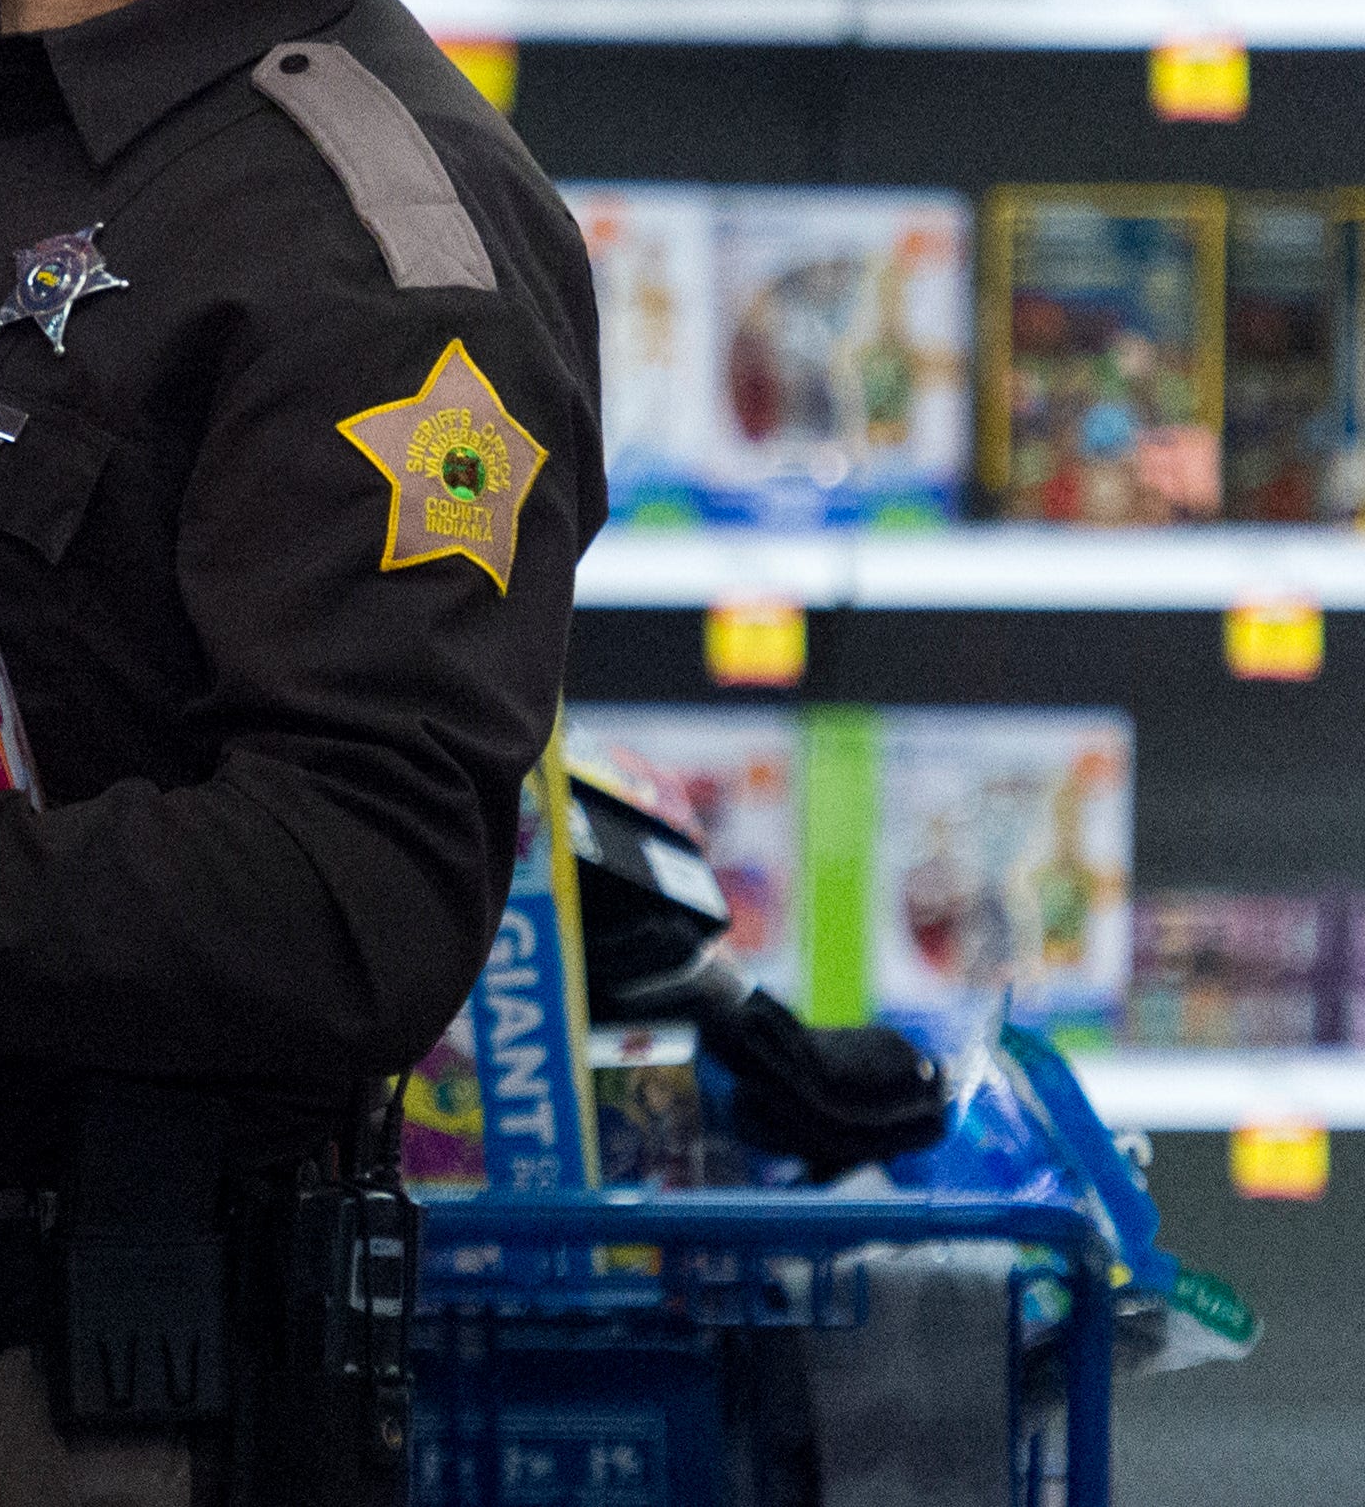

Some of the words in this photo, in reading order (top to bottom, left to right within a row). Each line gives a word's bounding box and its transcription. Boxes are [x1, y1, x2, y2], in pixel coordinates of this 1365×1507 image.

[406, 407, 472, 473] SHERIFF'S
[425, 427, 500, 493] VANDERBURGH
[426, 497, 494, 523] COUNTY
[426, 515, 493, 542] INDIANA
[485, 908, 555, 1146] GIANT
